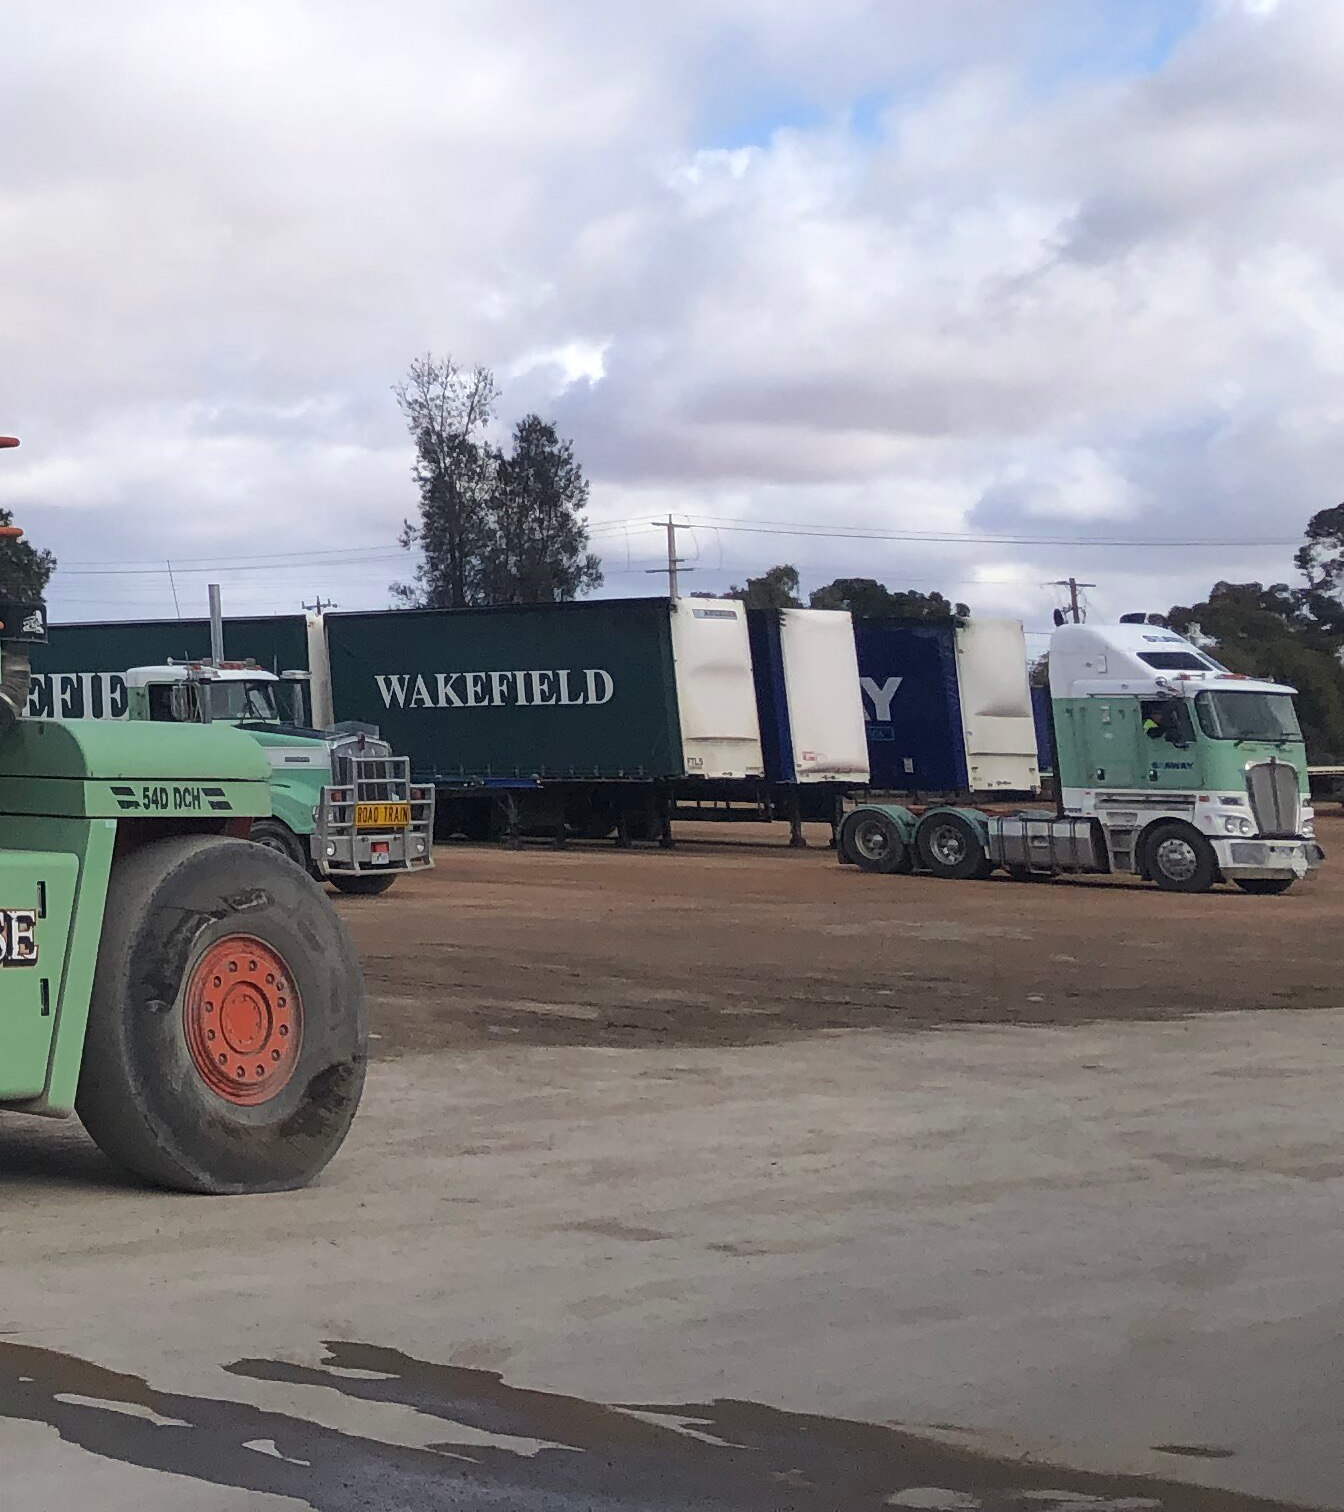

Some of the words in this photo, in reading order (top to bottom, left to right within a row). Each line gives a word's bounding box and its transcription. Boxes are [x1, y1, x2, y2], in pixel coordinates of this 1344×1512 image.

[374, 669, 614, 709] WAKEFIELD
[173, 787, 201, 810] DCH
[357, 806, 379, 823] ROAD
[384, 806, 408, 823] TRAIN
